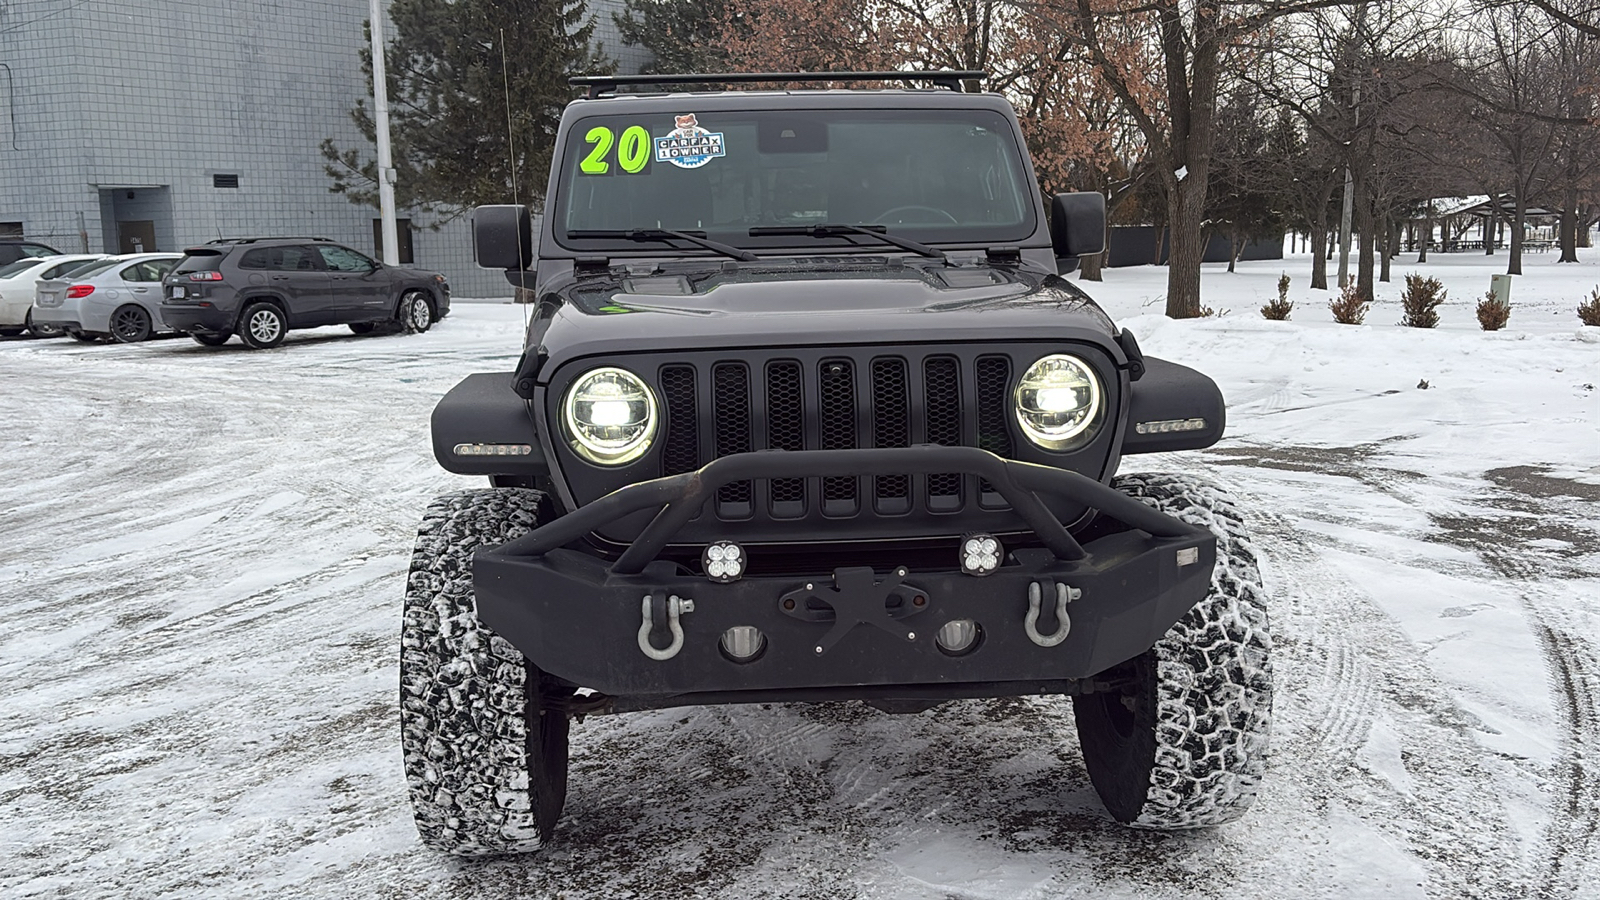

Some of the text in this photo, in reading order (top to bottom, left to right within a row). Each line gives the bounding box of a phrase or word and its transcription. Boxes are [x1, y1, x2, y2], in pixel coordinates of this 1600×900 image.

[660, 137, 719, 148] CARFAX
[580, 125, 651, 174] 20
[671, 146, 720, 156] OWNER
